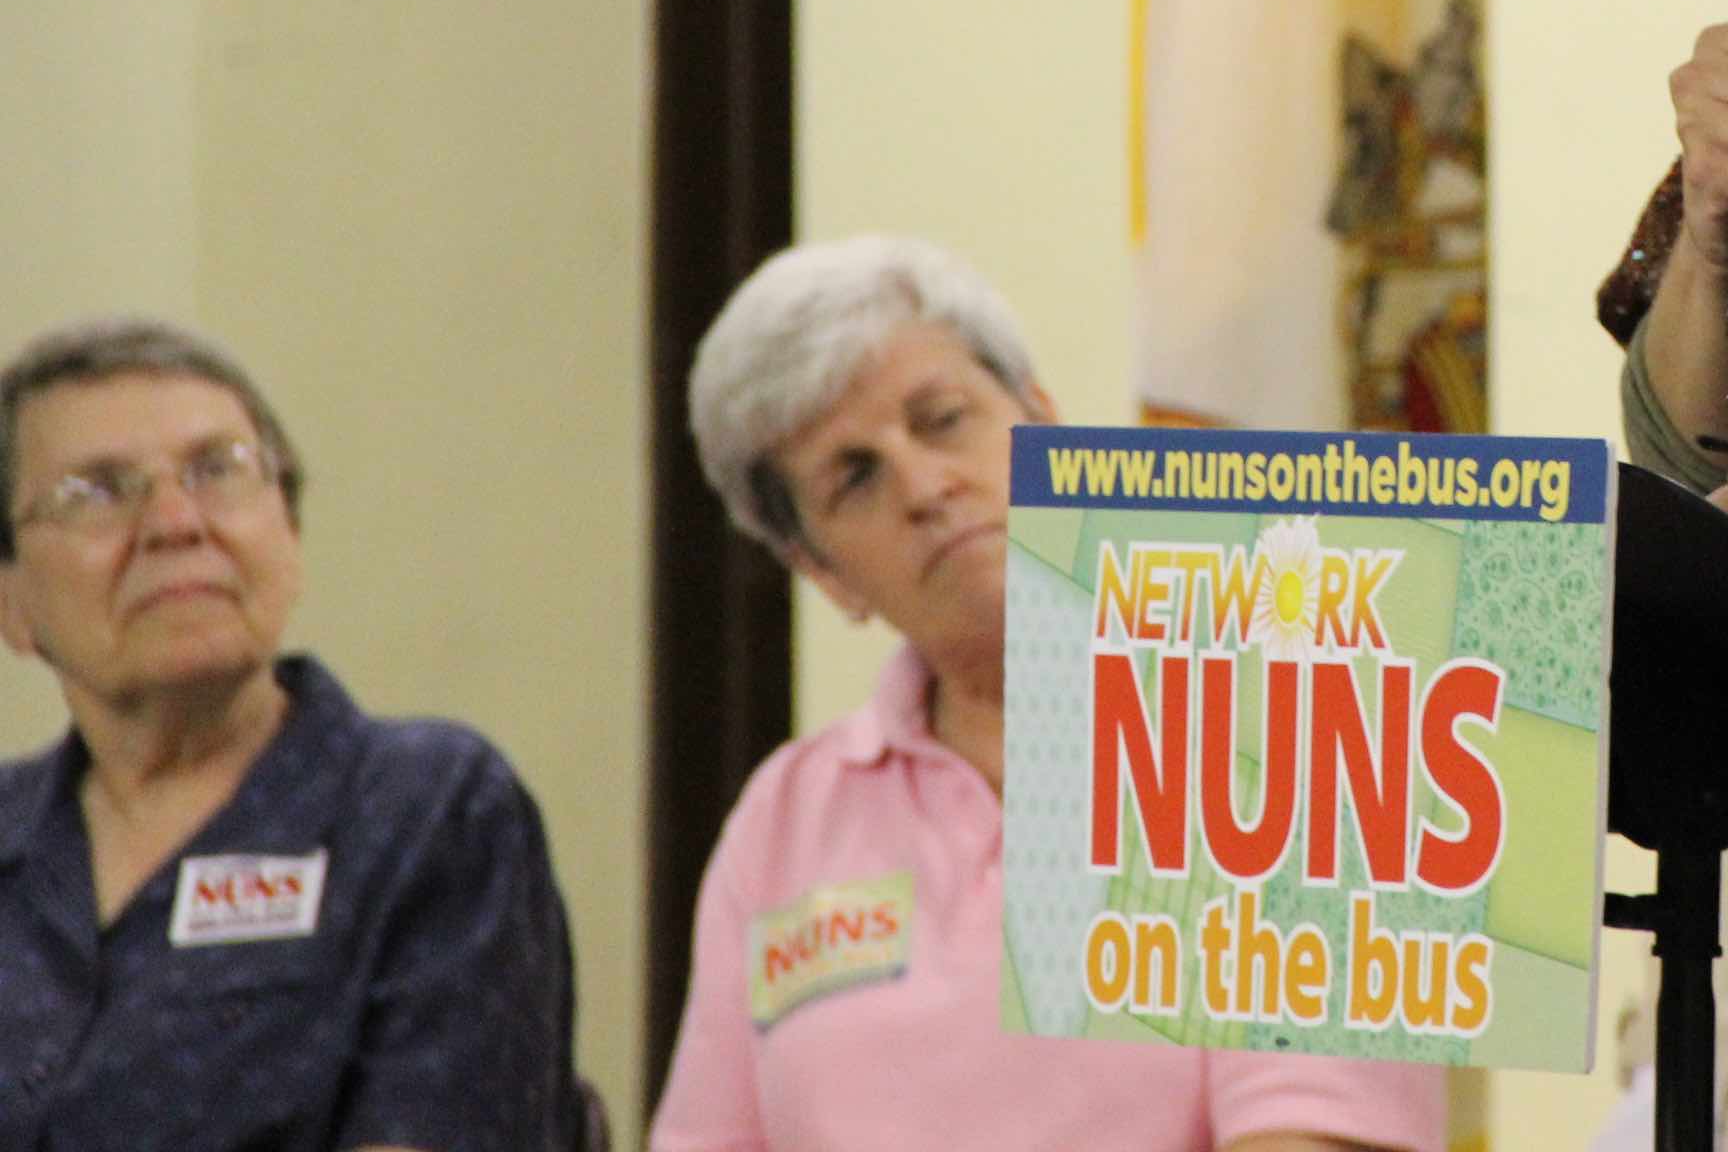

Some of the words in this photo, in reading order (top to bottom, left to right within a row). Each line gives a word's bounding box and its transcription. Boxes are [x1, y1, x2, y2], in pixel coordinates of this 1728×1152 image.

[1048, 440, 1571, 518] www.nunsonthebus.org
[1090, 653, 1503, 891] NUNS
[193, 873, 303, 907] NUNS
[765, 902, 898, 983] NUNS
[1086, 917, 1178, 1011] on
[1200, 891, 1328, 1020] the
[1348, 897, 1490, 1031] bus
